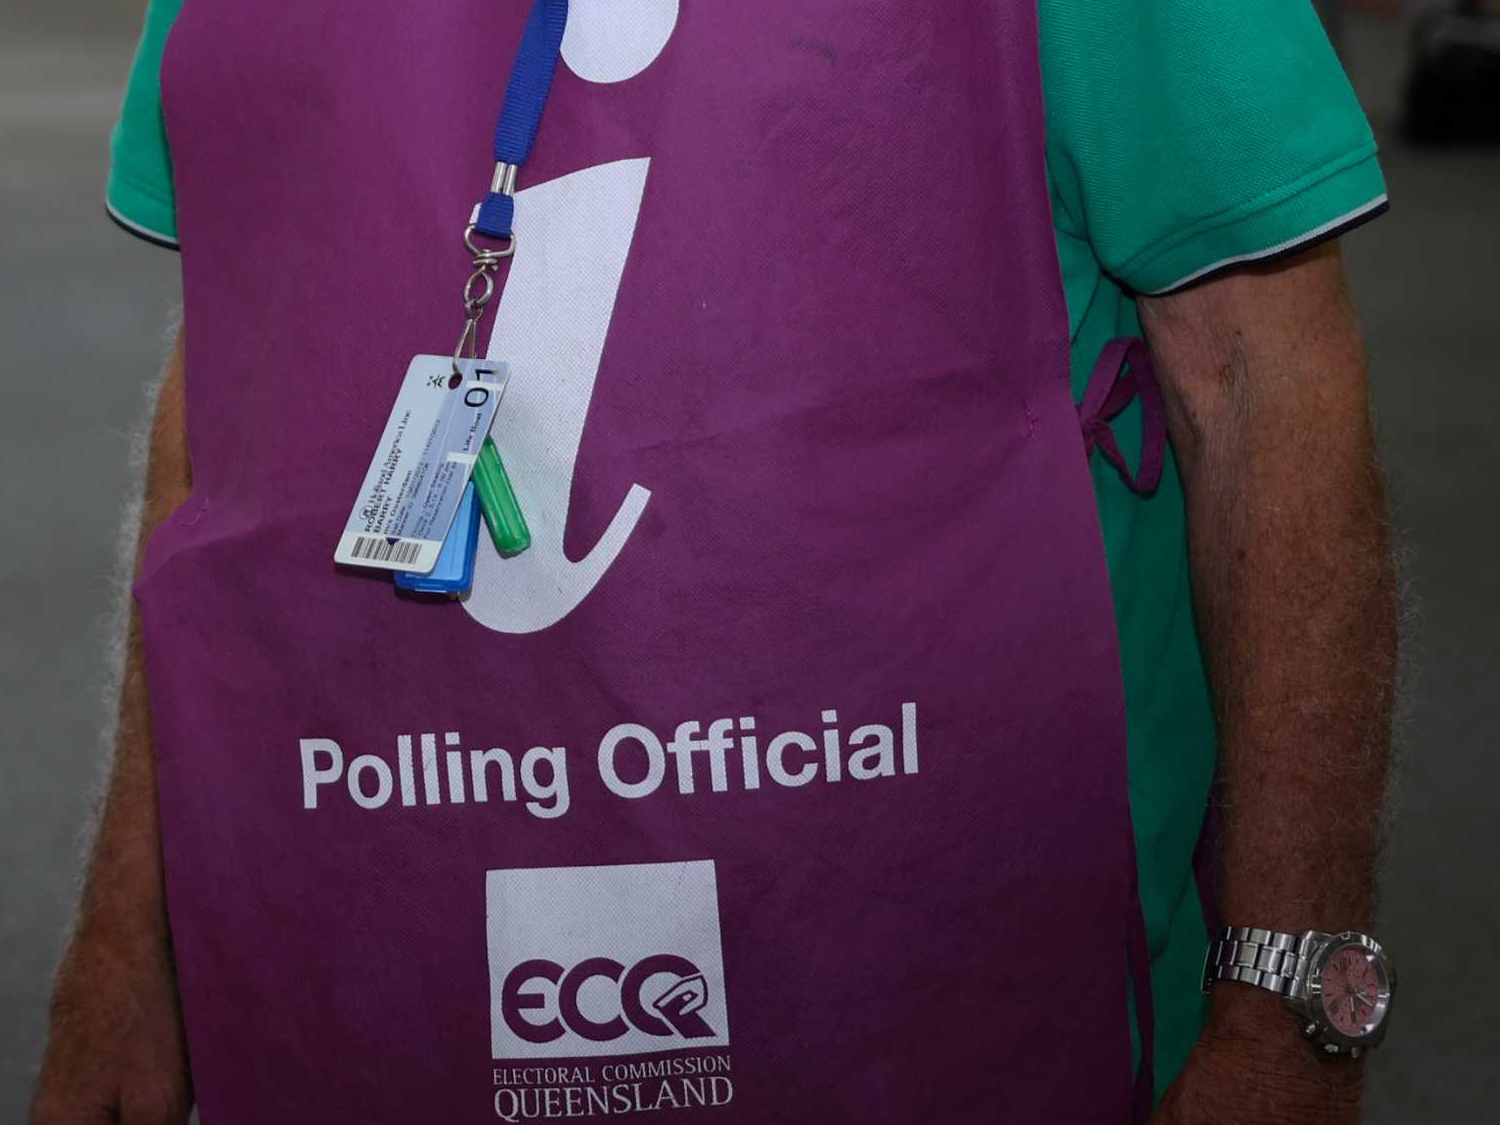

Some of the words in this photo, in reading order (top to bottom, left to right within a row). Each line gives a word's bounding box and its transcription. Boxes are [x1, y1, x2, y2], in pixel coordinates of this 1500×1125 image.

[373, 496, 393, 533] BARRY
[299, 731, 570, 819] Polling
[597, 702, 920, 799] Official
[501, 954, 717, 1044] ECQ
[493, 1065, 596, 1085] ELECTORAL
[602, 1055, 732, 1083] COMMISSION
[494, 1076, 734, 1123] QUEENSLAND
